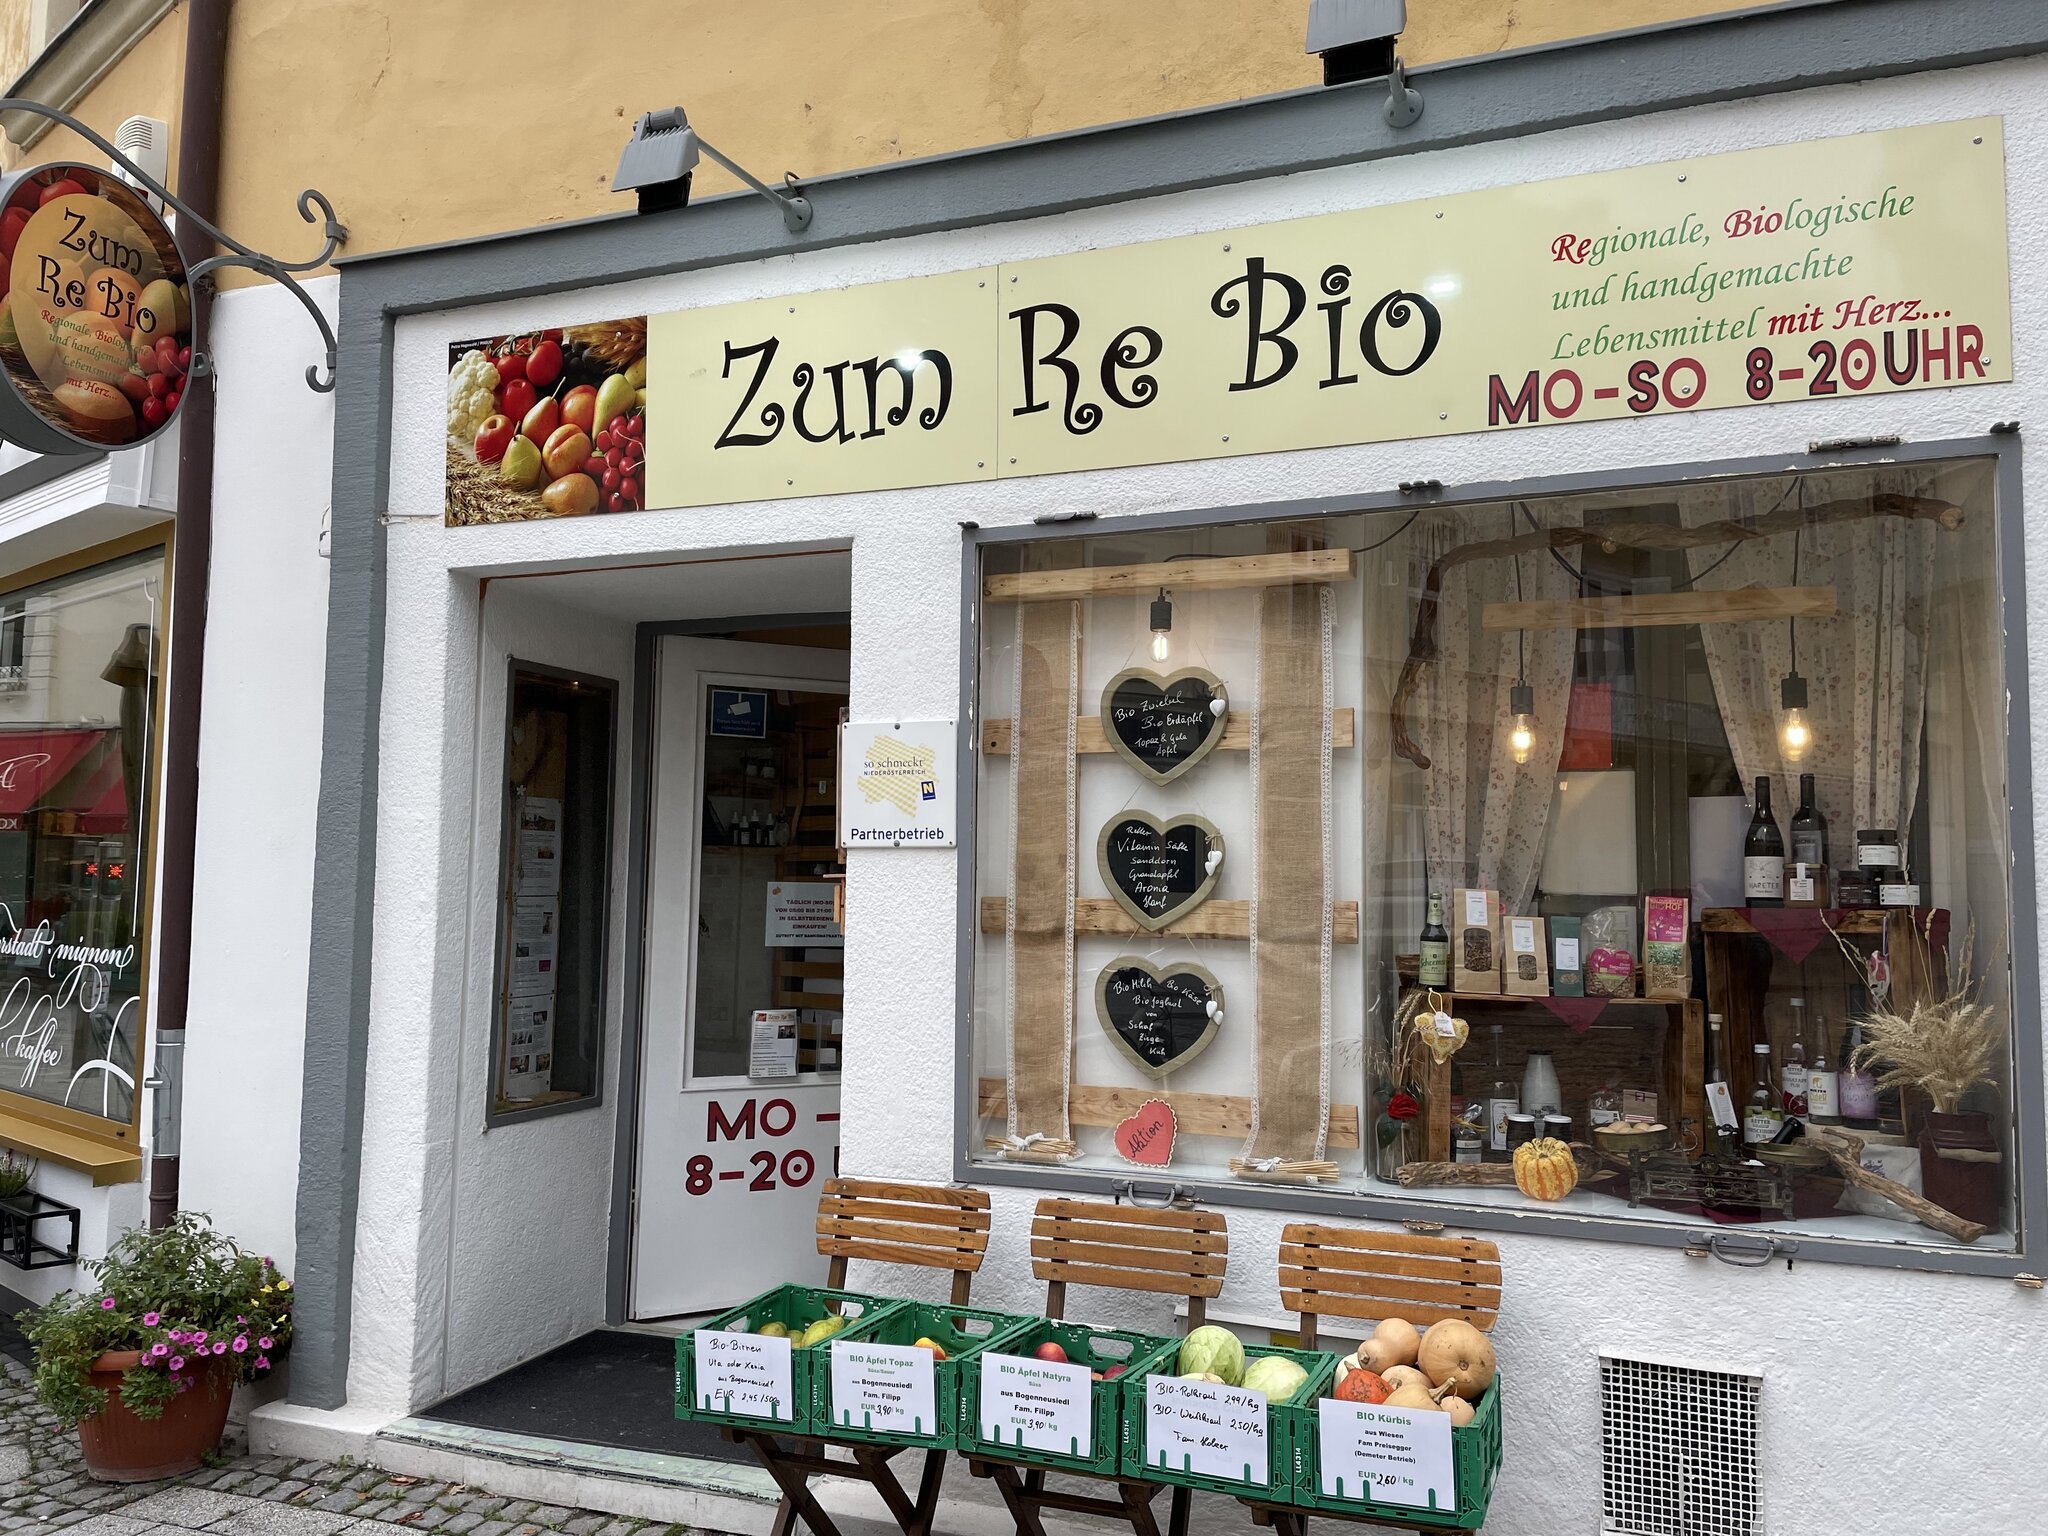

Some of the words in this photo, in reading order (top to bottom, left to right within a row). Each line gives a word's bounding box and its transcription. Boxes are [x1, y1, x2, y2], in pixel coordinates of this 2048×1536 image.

[1551, 212, 1712, 267] Regionale,
[1723, 185, 1916, 240] Biologische
[59, 206, 143, 277] Zum
[1552, 272, 1611, 312] und
[1620, 247, 1854, 305] handgemachte
[36, 254, 86, 308] Re
[97, 276, 157, 334] Bio
[41, 309, 92, 338] Regionale,
[1550, 306, 1765, 362] Lebensmittel
[1767, 303, 1825, 338] mit
[1831, 293, 1952, 331] Herz...
[49, 332, 70, 347] und
[714, 335, 953, 451] Zum
[1009, 302, 1164, 436] Re
[1211, 256, 1443, 393] Bio
[65, 376, 83, 389] mit
[1488, 357, 1708, 427] MO-SO
[1115, 708, 1136, 722] Bio
[1141, 715, 1163, 729] Bio
[863, 761, 875, 769] so
[877, 756, 925, 769] schmeckt
[851, 827, 944, 840] Partnerbetrieb
[1117, 838, 1160, 853] Vitamin
[1130, 856, 1177, 866] Sanddorn
[1128, 868, 1180, 882] Granatapfel
[1134, 881, 1170, 893] Aronia
[1113, 980, 1130, 995] Bio
[1166, 979, 1179, 991] Bio
[706, 1098, 797, 1142] MO
[1126, 1119, 1164, 1159] Aktion
[685, 1149, 815, 1196] 8-20
[849, 1354, 864, 1363] BIO
[866, 1355, 887, 1366] Äpfel
[888, 1358, 914, 1368] Topaz
[1000, 1365, 1016, 1374] BIO
[1018, 1366, 1040, 1378] Äpfel
[1042, 1371, 1072, 1383] Natyra
[861, 1378, 913, 1390] Bogenneusiedl
[715, 1388, 735, 1400] EUR
[863, 1391, 880, 1399] Fam.
[1015, 1391, 1070, 1406] Bogenneusiedl
[861, 1403, 876, 1411] EUR
[896, 1406, 905, 1415] kg
[1014, 1404, 1033, 1414] Fam.
[1011, 1416, 1027, 1425] EUR
[1048, 1422, 1058, 1431] kg
[1356, 1411, 1375, 1422] BIO
[1378, 1413, 1412, 1426] Kürbis
[1378, 1430, 1404, 1439] Wiesen
[1358, 1439, 1373, 1447] Fam
[1354, 1450, 1387, 1461] (Demeter
[1387, 1454, 1416, 1464] Betrieb)
[1358, 1470, 1377, 1480] EUR
[1403, 1476, 1414, 1486] kg
